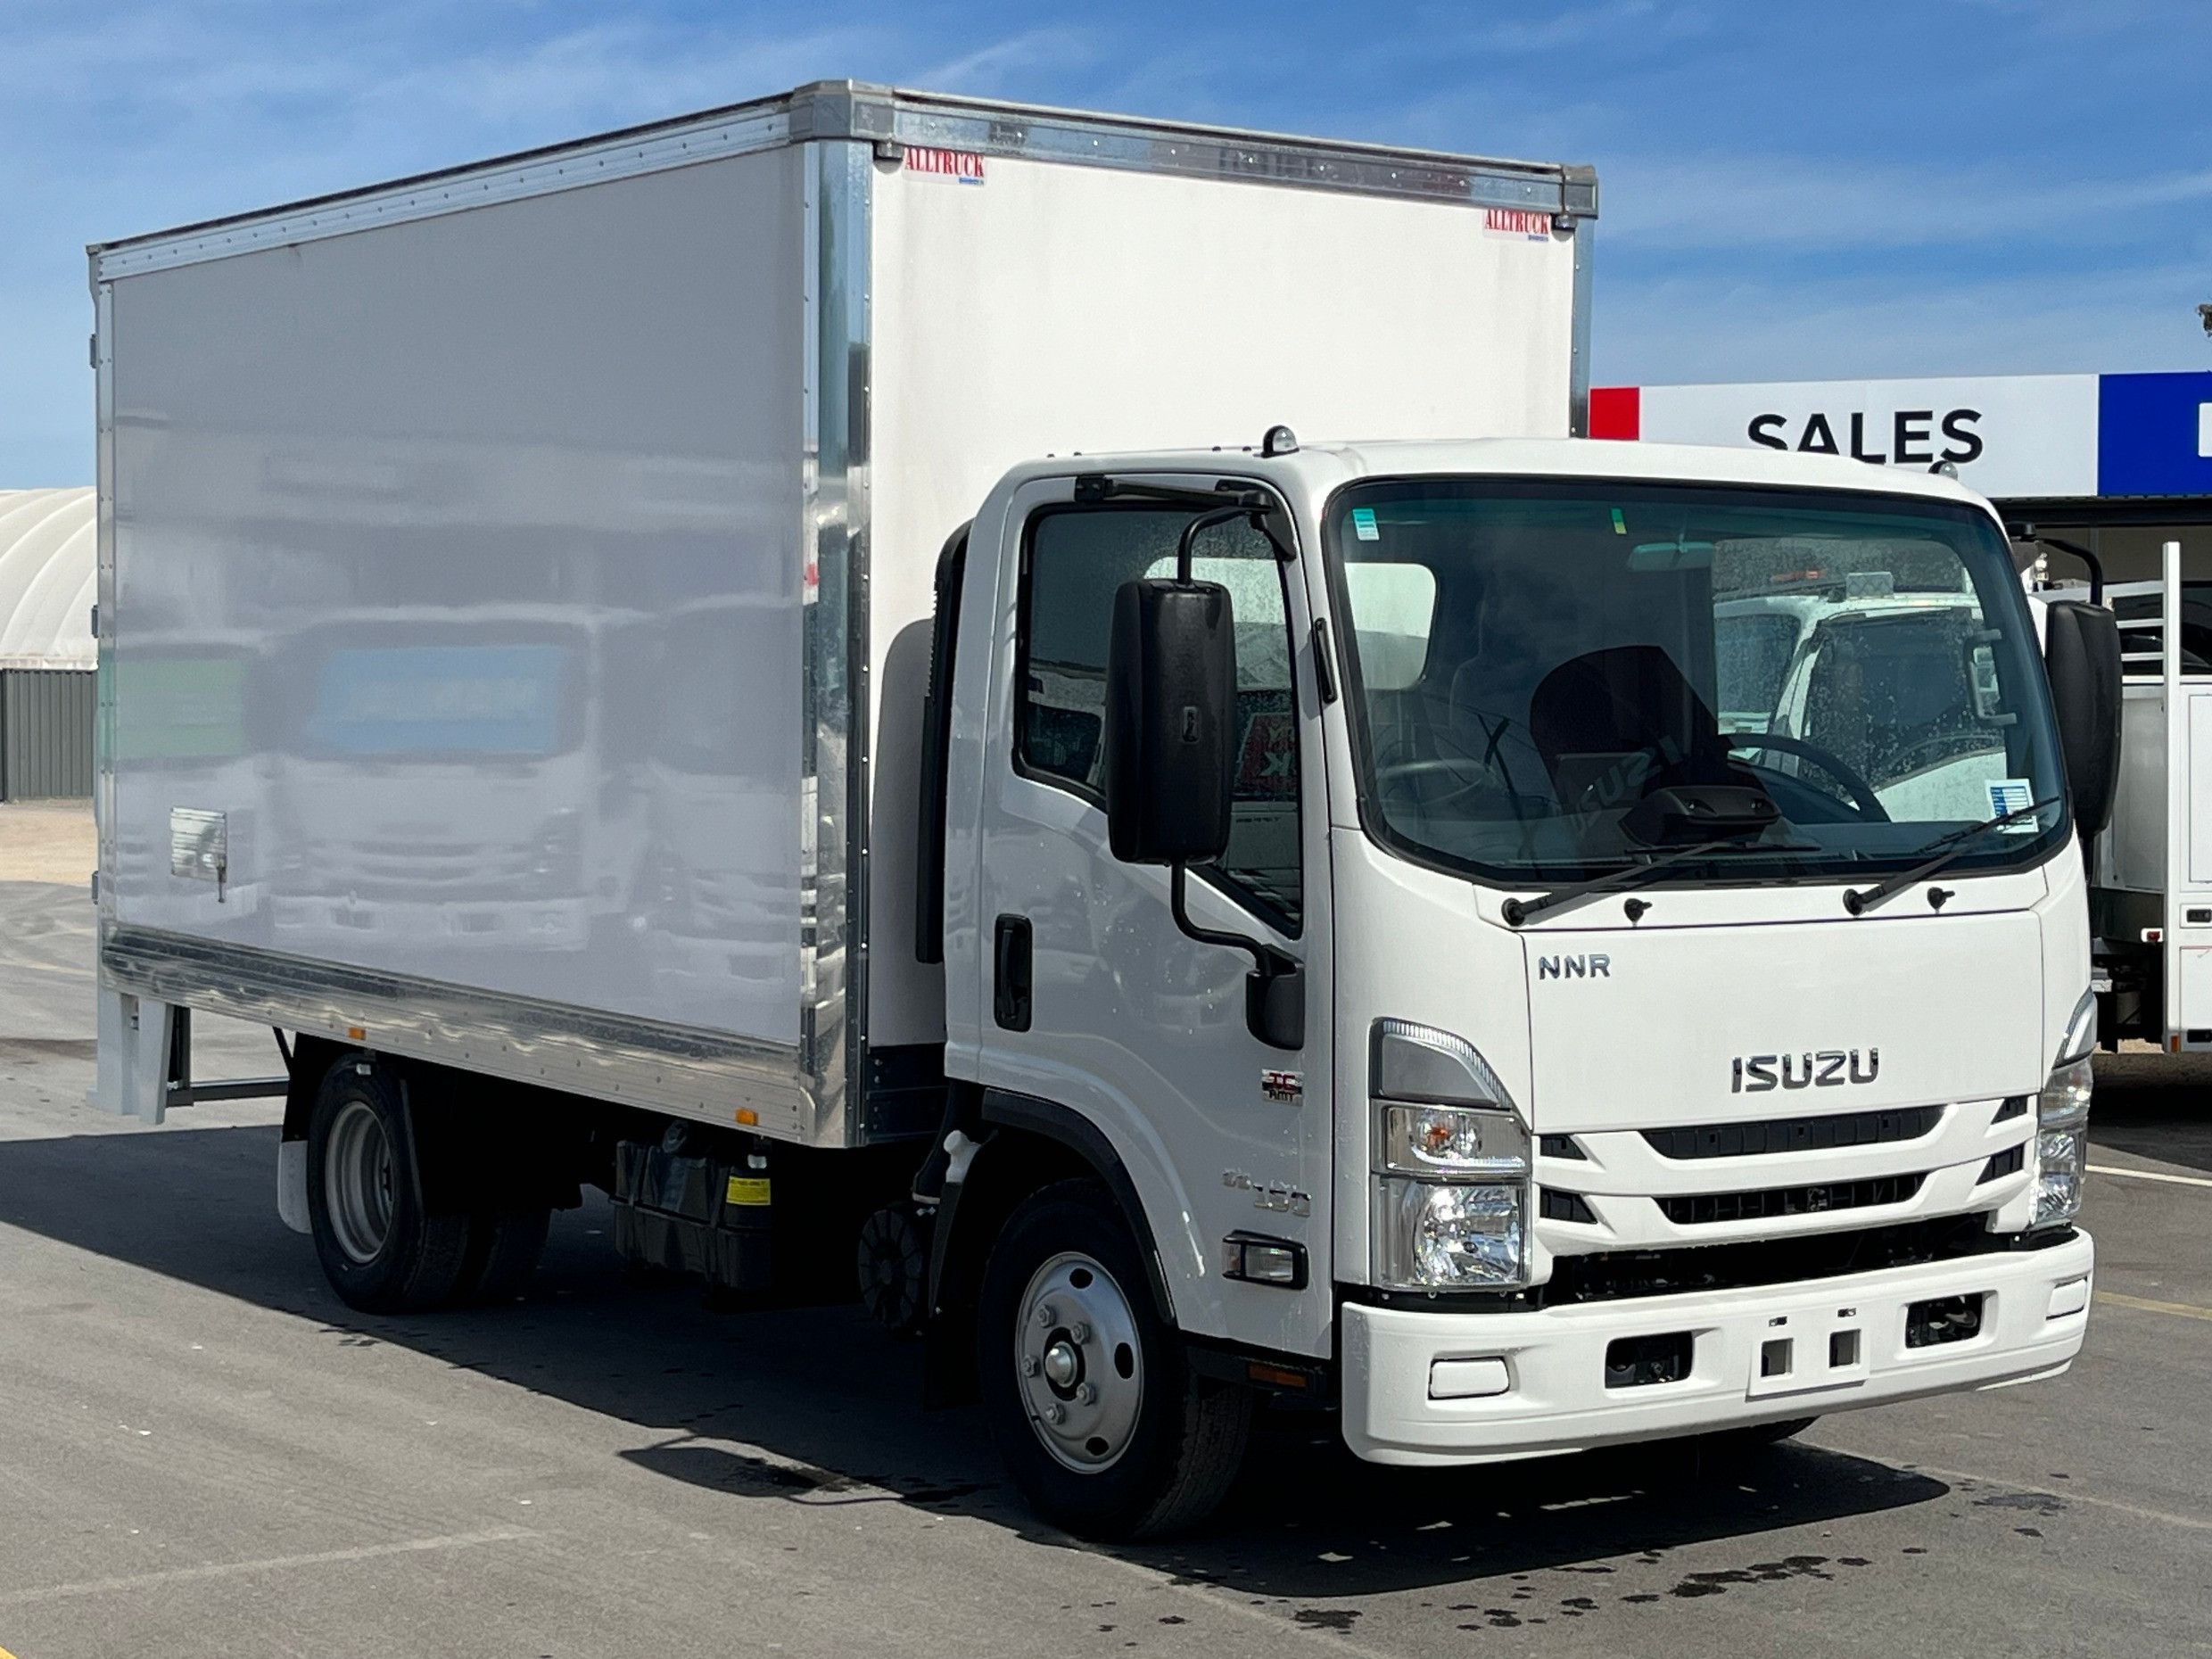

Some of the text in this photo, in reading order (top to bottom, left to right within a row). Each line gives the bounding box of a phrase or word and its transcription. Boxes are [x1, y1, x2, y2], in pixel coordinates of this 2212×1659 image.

[904, 147, 985, 177] ALLTRUCK
[1484, 209, 1549, 235] ALLTRUCK
[1747, 409, 1983, 465] SALES
[1538, 953, 1612, 980] NNR
[1730, 1047, 1879, 1094] ISUZU
